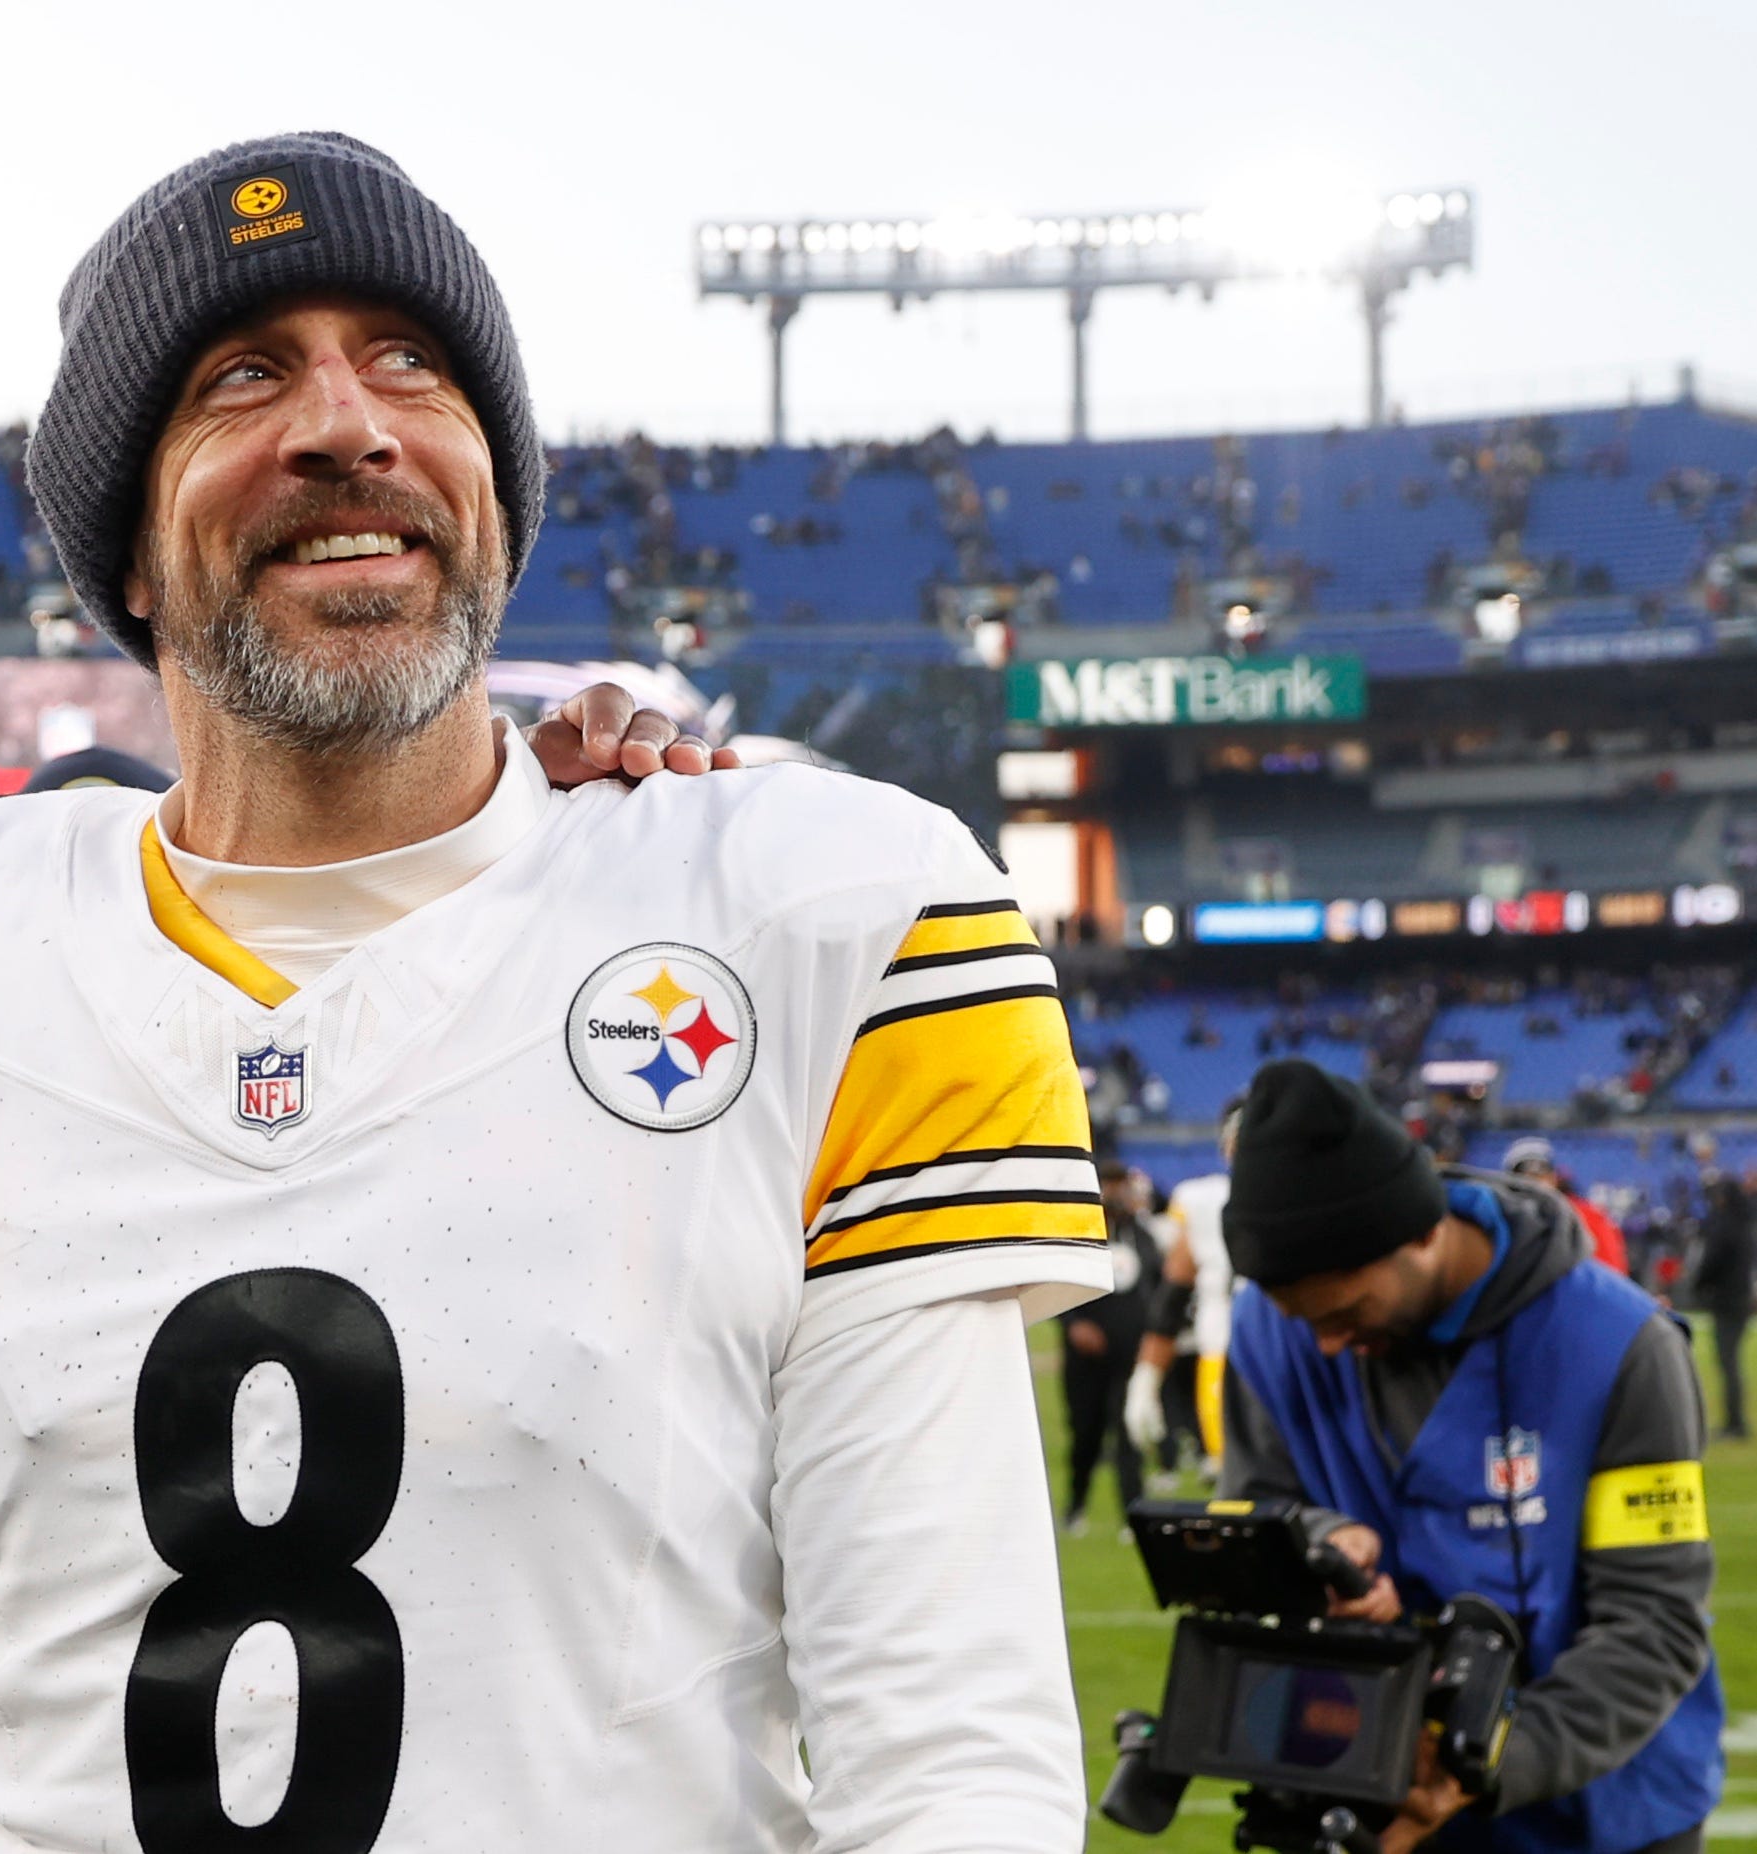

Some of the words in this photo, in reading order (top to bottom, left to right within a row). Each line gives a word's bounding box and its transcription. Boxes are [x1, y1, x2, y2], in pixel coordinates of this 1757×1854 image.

[230, 217, 304, 245] STEELERS
[1040, 657, 1186, 726] M&T
[1190, 654, 1334, 722] Bank
[588, 1018, 660, 1041] Steelers
[244, 1080, 297, 1119] NFL
[124, 1267, 405, 1854] 8
